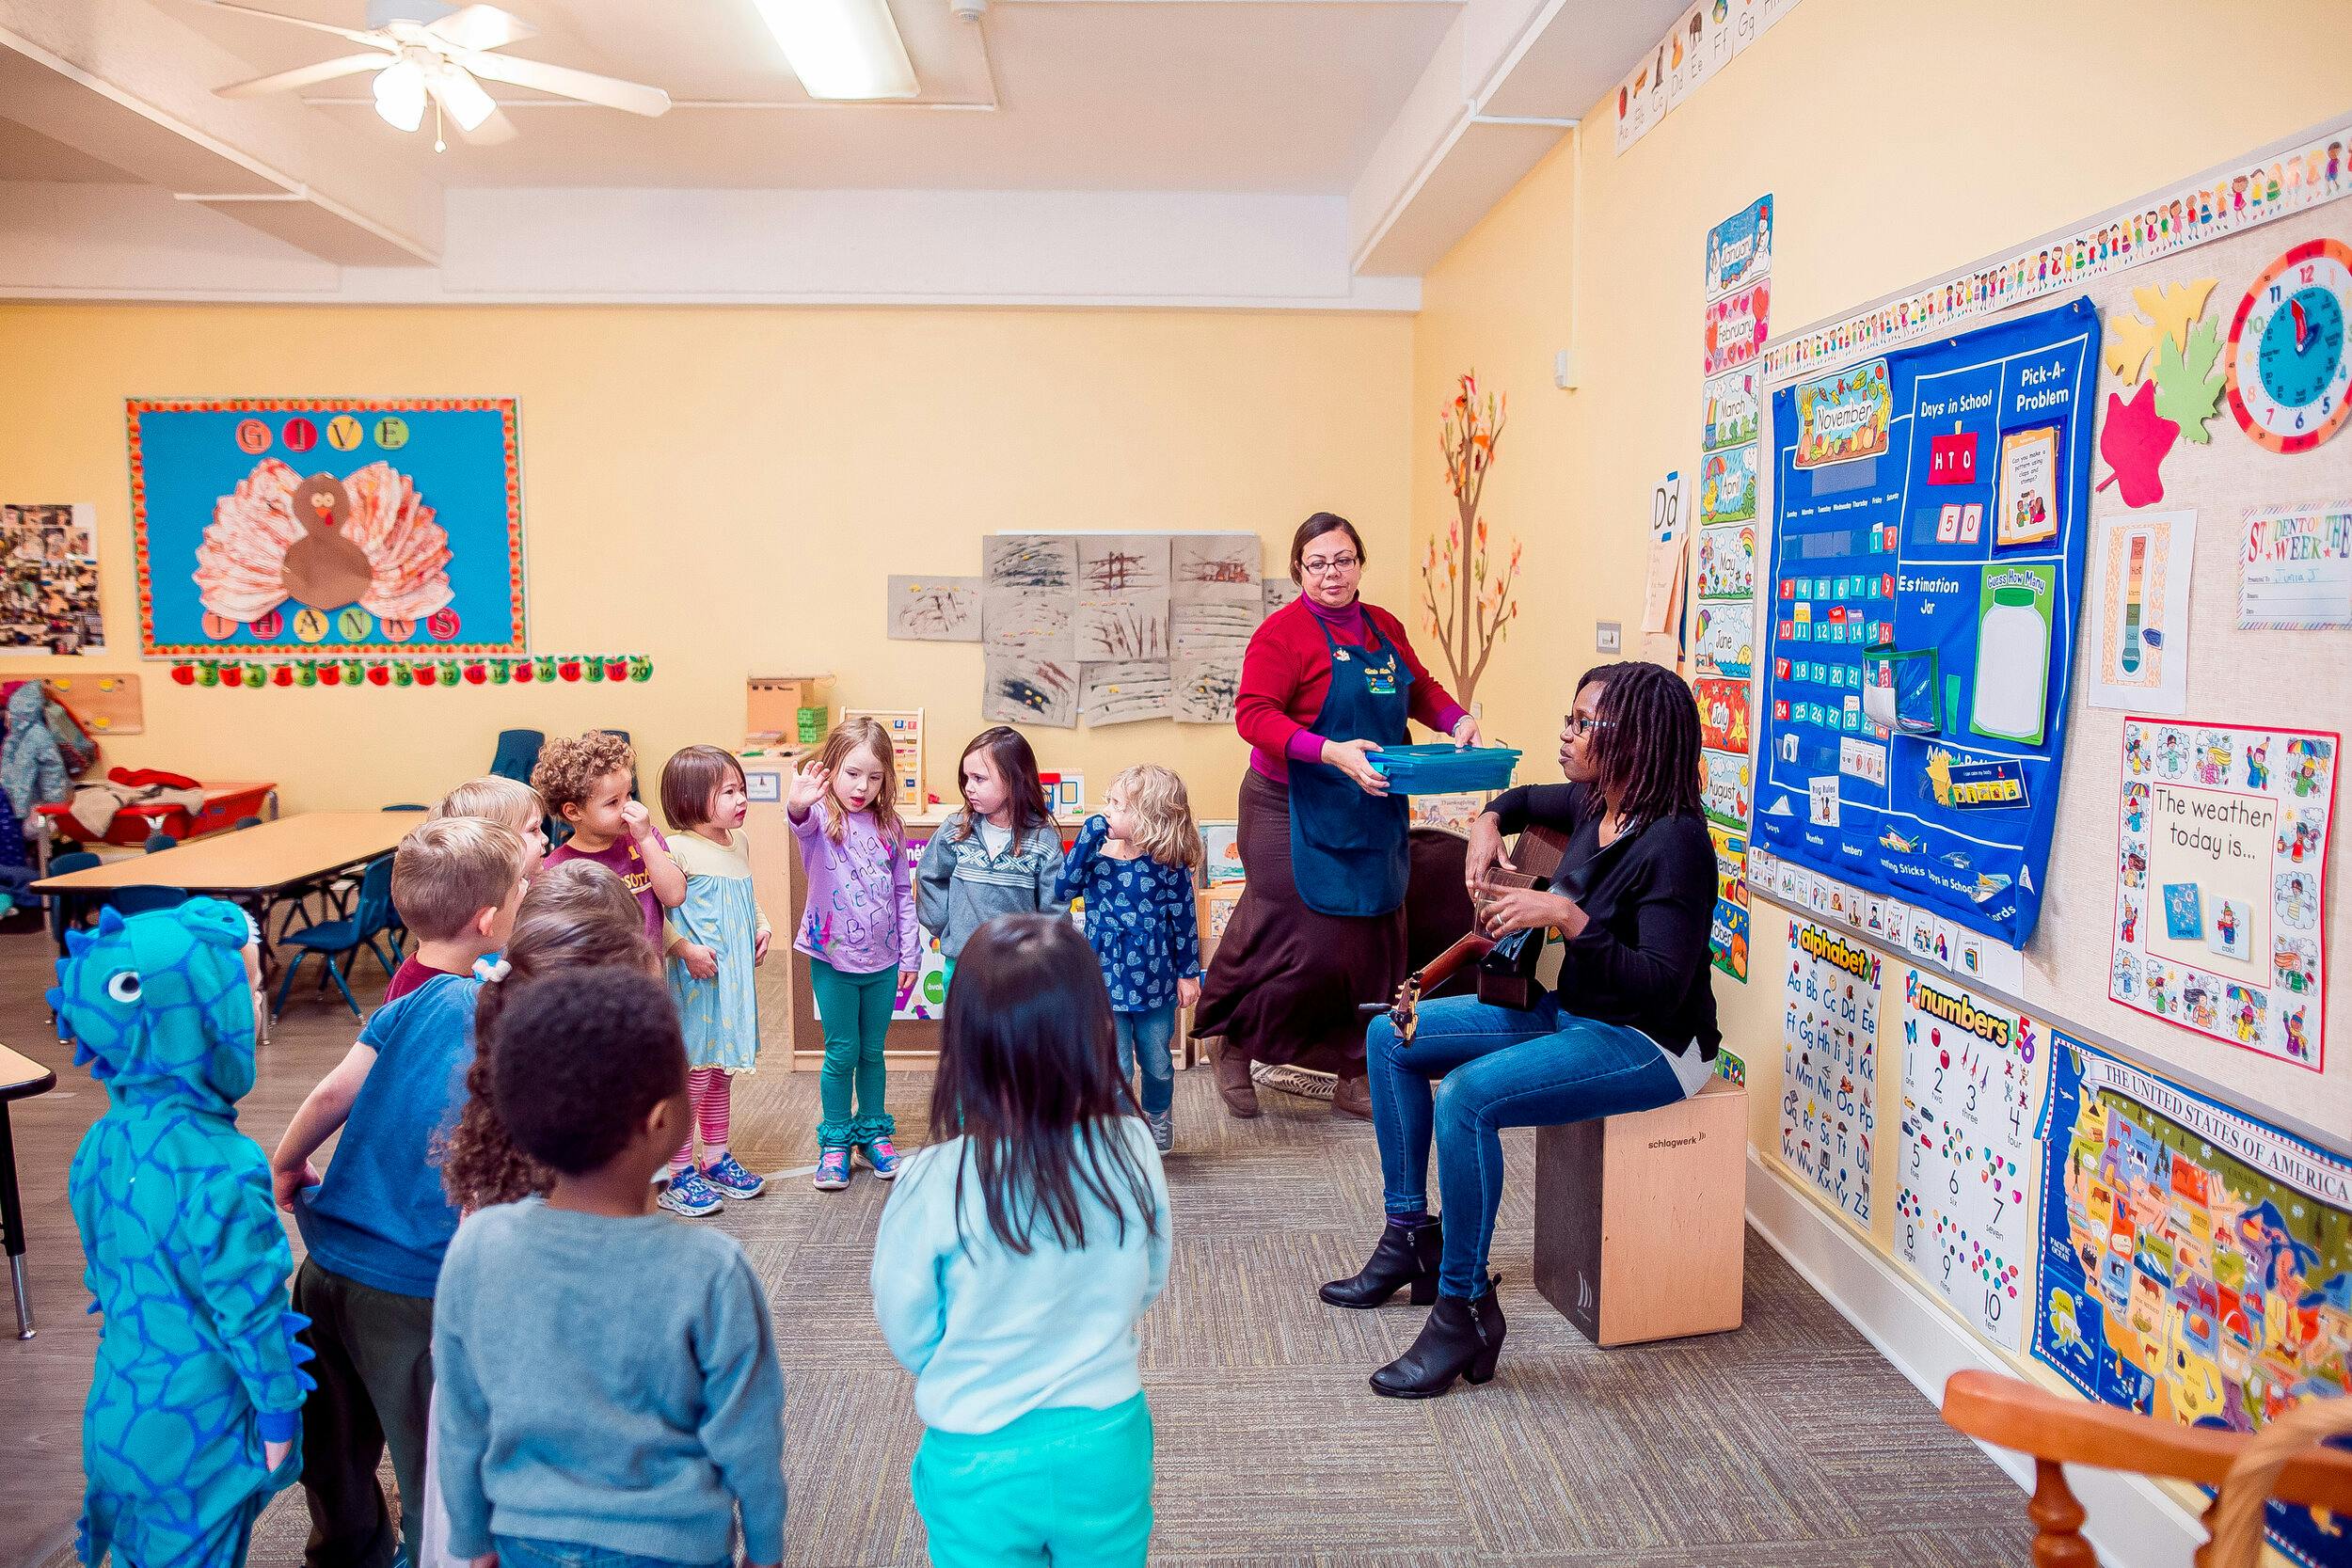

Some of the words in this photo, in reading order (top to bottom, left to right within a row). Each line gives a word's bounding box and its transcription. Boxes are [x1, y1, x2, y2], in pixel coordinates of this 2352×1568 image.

[1713, 27, 1728, 59] Ff
[1738, 11, 1755, 40] Gg
[1722, 239, 1753, 262] January
[2299, 264, 2314, 283] 12
[2269, 285, 2280, 303] 11
[1718, 321, 1754, 346] February
[2248, 315, 2264, 334] 10
[2021, 360, 2066, 387] Pick-A-
[1721, 398, 1745, 419] March
[1920, 401, 1945, 420] Days
[1947, 397, 1958, 414] in
[1960, 388, 1993, 412] School
[2016, 388, 2069, 412] Problem
[1817, 403, 1872, 430] November
[2265, 407, 2274, 425] 7
[2295, 411, 2304, 429] 6
[2322, 396, 2330, 415] 5
[241, 420, 402, 450] GIVE
[1934, 451, 1943, 470] H
[1948, 451, 1954, 470] T
[1723, 474, 1740, 499] April
[1654, 479, 1680, 531] Dd
[1945, 515, 1954, 532] 5
[1966, 515, 1975, 532] 0
[1873, 533, 1878, 549] 1
[1887, 531, 1893, 546] 2
[2275, 535, 2322, 562] WEEK
[2326, 514, 2352, 559] THE
[1719, 553, 1736, 577] May
[1784, 582, 1789, 596] 3
[1801, 582, 1807, 596] 4
[1819, 583, 1825, 597] 5
[1837, 583, 1844, 597] 6
[1854, 578, 1861, 593] 7
[1871, 581, 1877, 595] 8
[1884, 578, 1890, 594] 9
[1898, 575, 1960, 594] Estimation
[1987, 575, 2007, 589] Guess
[2007, 569, 2023, 584] How
[2025, 571, 2045, 594] Many
[1920, 599, 1935, 615] Jar
[1715, 629, 1732, 650] June
[1781, 625, 1790, 638] 10
[1797, 625, 1806, 638] 11
[1817, 625, 1828, 639] 12
[1834, 626, 1843, 641] 13
[1851, 625, 1862, 641] 14
[1868, 623, 1878, 640] 15
[1882, 626, 1889, 641] 16
[631, 666, 650, 678] 20
[1795, 664, 1807, 678] 18
[1832, 669, 1842, 685] 20
[1711, 705, 1728, 734] July
[1795, 705, 1806, 720] 25
[1847, 713, 1857, 728] 28
[1708, 778, 1736, 803] August
[1812, 784, 1821, 796] Rug
[2155, 788, 2185, 815] The
[2191, 800, 2273, 828] weather
[1765, 822, 1780, 833] Days
[1805, 831, 1823, 846] Months
[2169, 822, 2222, 860] today
[2227, 833, 2256, 860] is...
[850, 859, 877, 881] and
[1880, 858, 1899, 874] unting
[1899, 863, 1926, 877] Sticks
[1942, 876, 1948, 887] in
[1950, 879, 1974, 895] Schoo
[1801, 924, 1867, 978] alphabet
[2221, 945, 2234, 954] cold
[927, 982, 943, 991] óval
[1788, 970, 1801, 992] Aa
[1806, 978, 1818, 1002] Bb
[1823, 989, 1836, 1013] Cc
[1841, 997, 1856, 1024] Dd
[1862, 1008, 1875, 1035] Ee
[1920, 985, 2010, 1049] numbers
[1799, 1021, 1813, 1050] Gg
[1817, 1029, 1830, 1055] Hh
[1845, 1047, 1854, 1074] Jj
[1859, 1054, 1874, 1082] Kk
[1905, 1077, 1915, 1088] one
[1934, 1066, 1944, 1094] 2
[1795, 1062, 1813, 1090] Mm
[1818, 1075, 1832, 1103] Nn
[1836, 1090, 1854, 1117] Oo
[1859, 1102, 1873, 1132] Pp
[1931, 1092, 1944, 1104] two
[1965, 1084, 1976, 1112] 3
[1962, 1108, 1979, 1125] three
[2010, 1106, 2020, 1137] 4
[1647, 1136, 1697, 1149] schlagwerk
[1784, 1095, 1799, 1128] Qq
[1803, 1109, 1814, 1132] Rr
[1820, 1122, 1830, 1146] Ss
[1856, 1146, 1870, 1175] Uu
[2007, 1132, 2023, 1149] four
[2105, 1064, 2129, 1086] THE
[2131, 1074, 2182, 1117] UNITED
[2185, 1103, 2239, 1148] STATES
[2243, 1138, 2265, 1164] OF
[2267, 1147, 2350, 1201] AMERICA
[1912, 1142, 1921, 1168] 5
[1797, 1146, 1814, 1177] Ww
[1817, 1164, 1832, 1192] Xx
[1853, 1192, 1869, 1221] Zz
[1910, 1166, 1919, 1180] five
[1948, 1169, 1959, 1195] 6
[1949, 1196, 1958, 1208] six
[1993, 1196, 2004, 1224] 7
[1906, 1224, 1915, 1249] 8
[1985, 1224, 2004, 1242] seven
[1904, 1248, 1916, 1263] eight
[2050, 1236, 2071, 1255] PACIFIC
[2051, 1245, 2070, 1263] OCEAN
[1943, 1254, 1951, 1280] 9
[1940, 1280, 1951, 1295] nine
[1984, 1289, 2001, 1322] 10
[1985, 1318, 1997, 1334] ten
